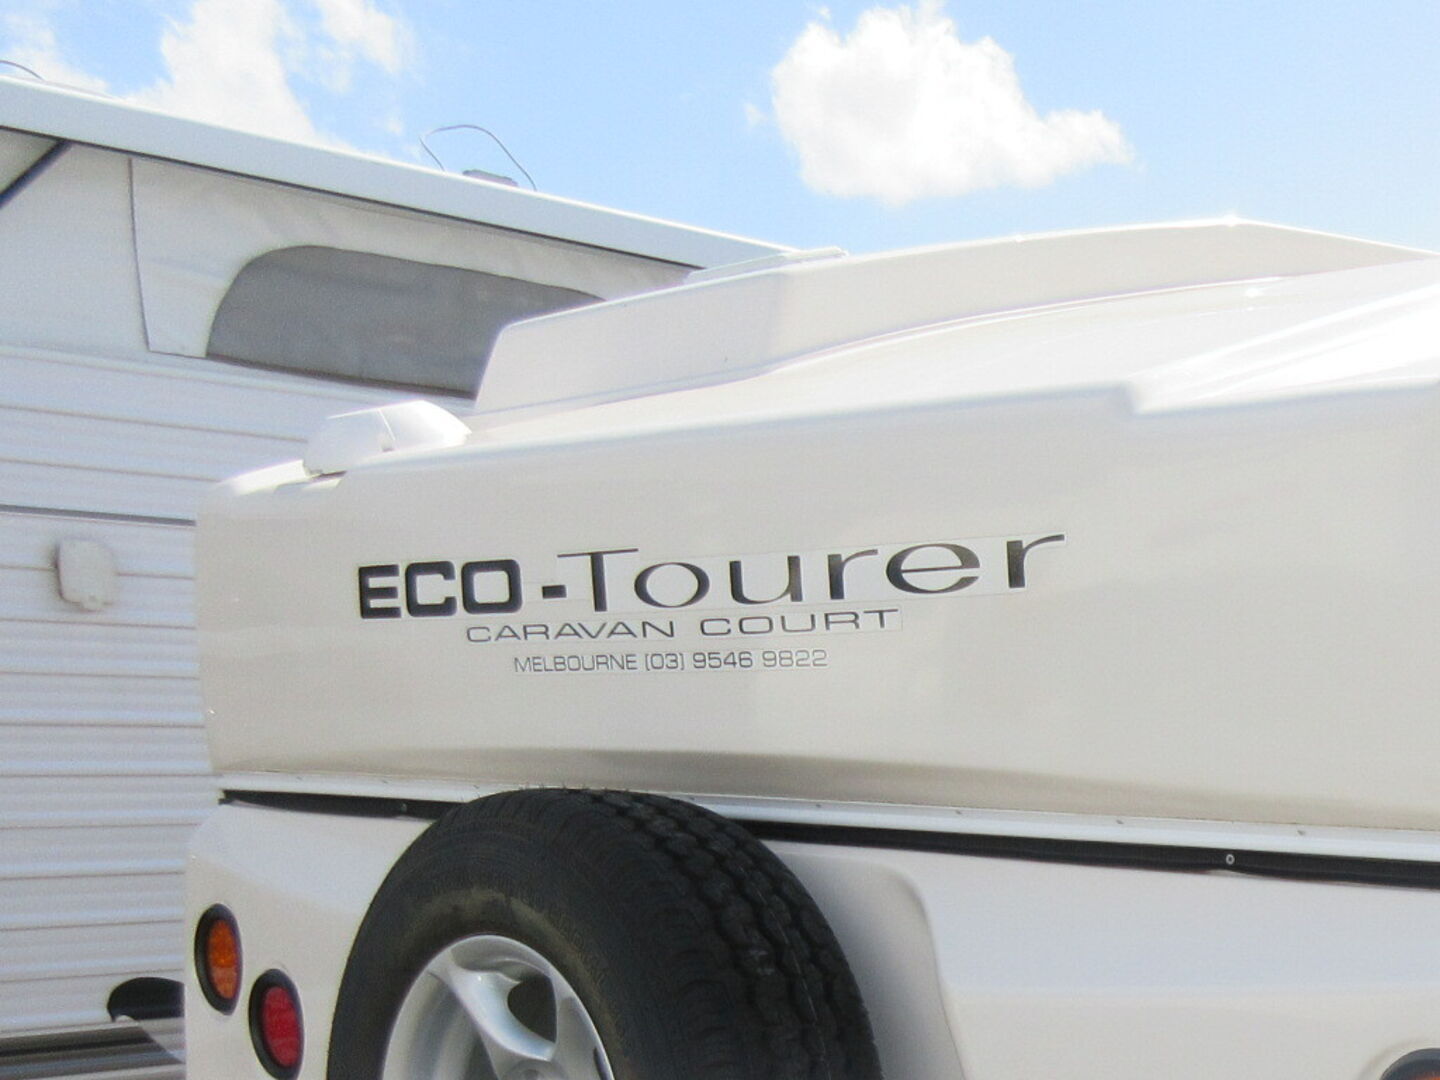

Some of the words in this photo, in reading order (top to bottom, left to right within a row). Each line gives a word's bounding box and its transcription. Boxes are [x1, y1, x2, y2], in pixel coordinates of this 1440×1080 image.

[358, 532, 1066, 619] ECO-Tourer
[465, 619, 675, 644] CARAVAN
[699, 608, 900, 637] COURT
[513, 653, 639, 673] MELBOURNE
[692, 649, 754, 670] 9546
[762, 648, 829, 668] 9822
